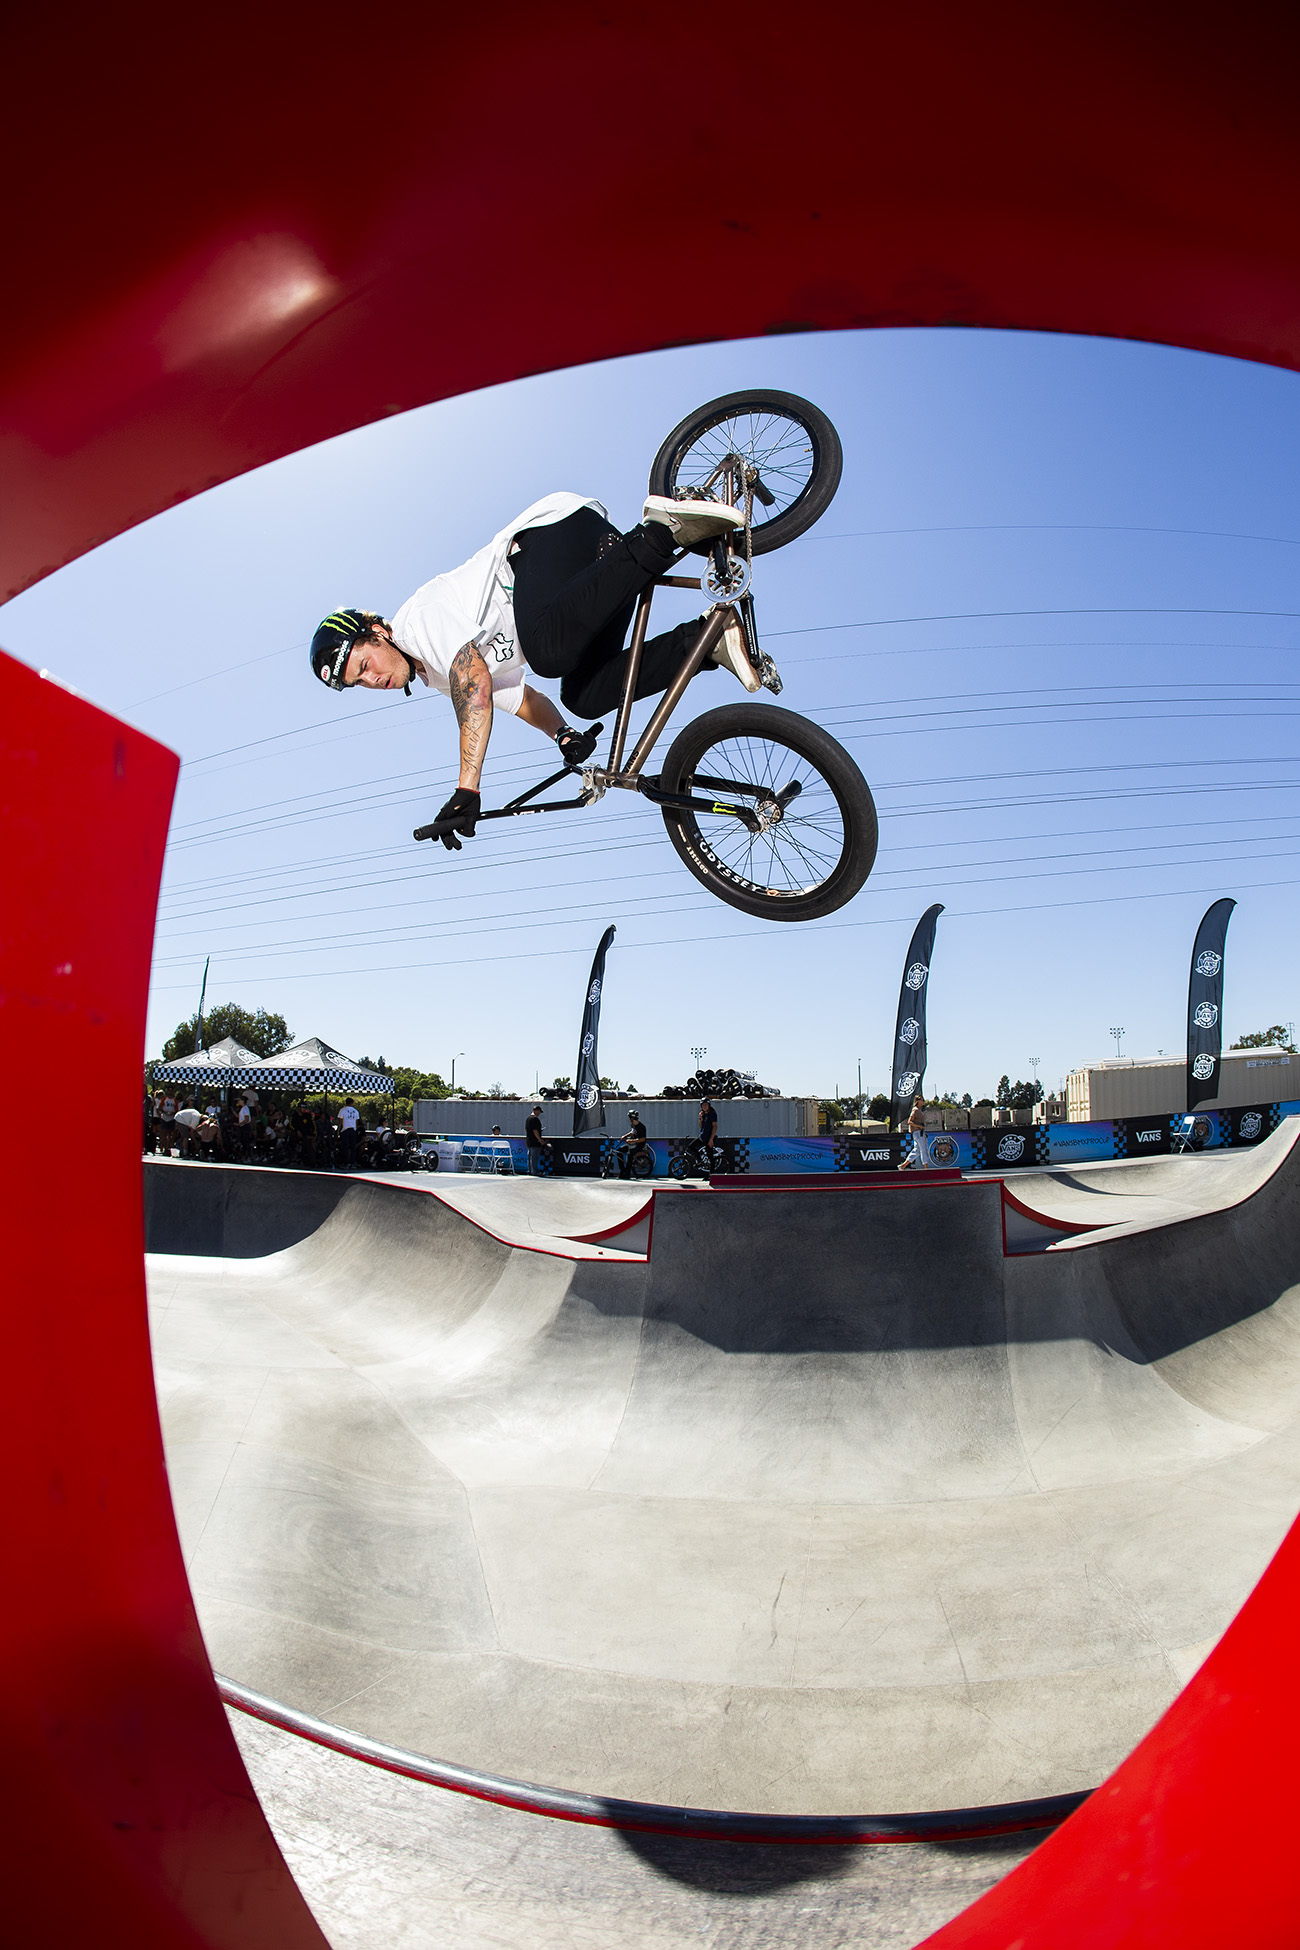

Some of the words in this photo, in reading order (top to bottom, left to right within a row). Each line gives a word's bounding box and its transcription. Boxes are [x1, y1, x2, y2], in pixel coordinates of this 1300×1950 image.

[333, 640, 349, 676] mongoose
[699, 840, 761, 892] ODYSSEY
[1135, 1130, 1162, 1142] VANS
[562, 1152, 591, 1164] VANS
[760, 1153, 824, 1161] @VANSBMXPROCUP
[859, 1149, 891, 1161] VANS
